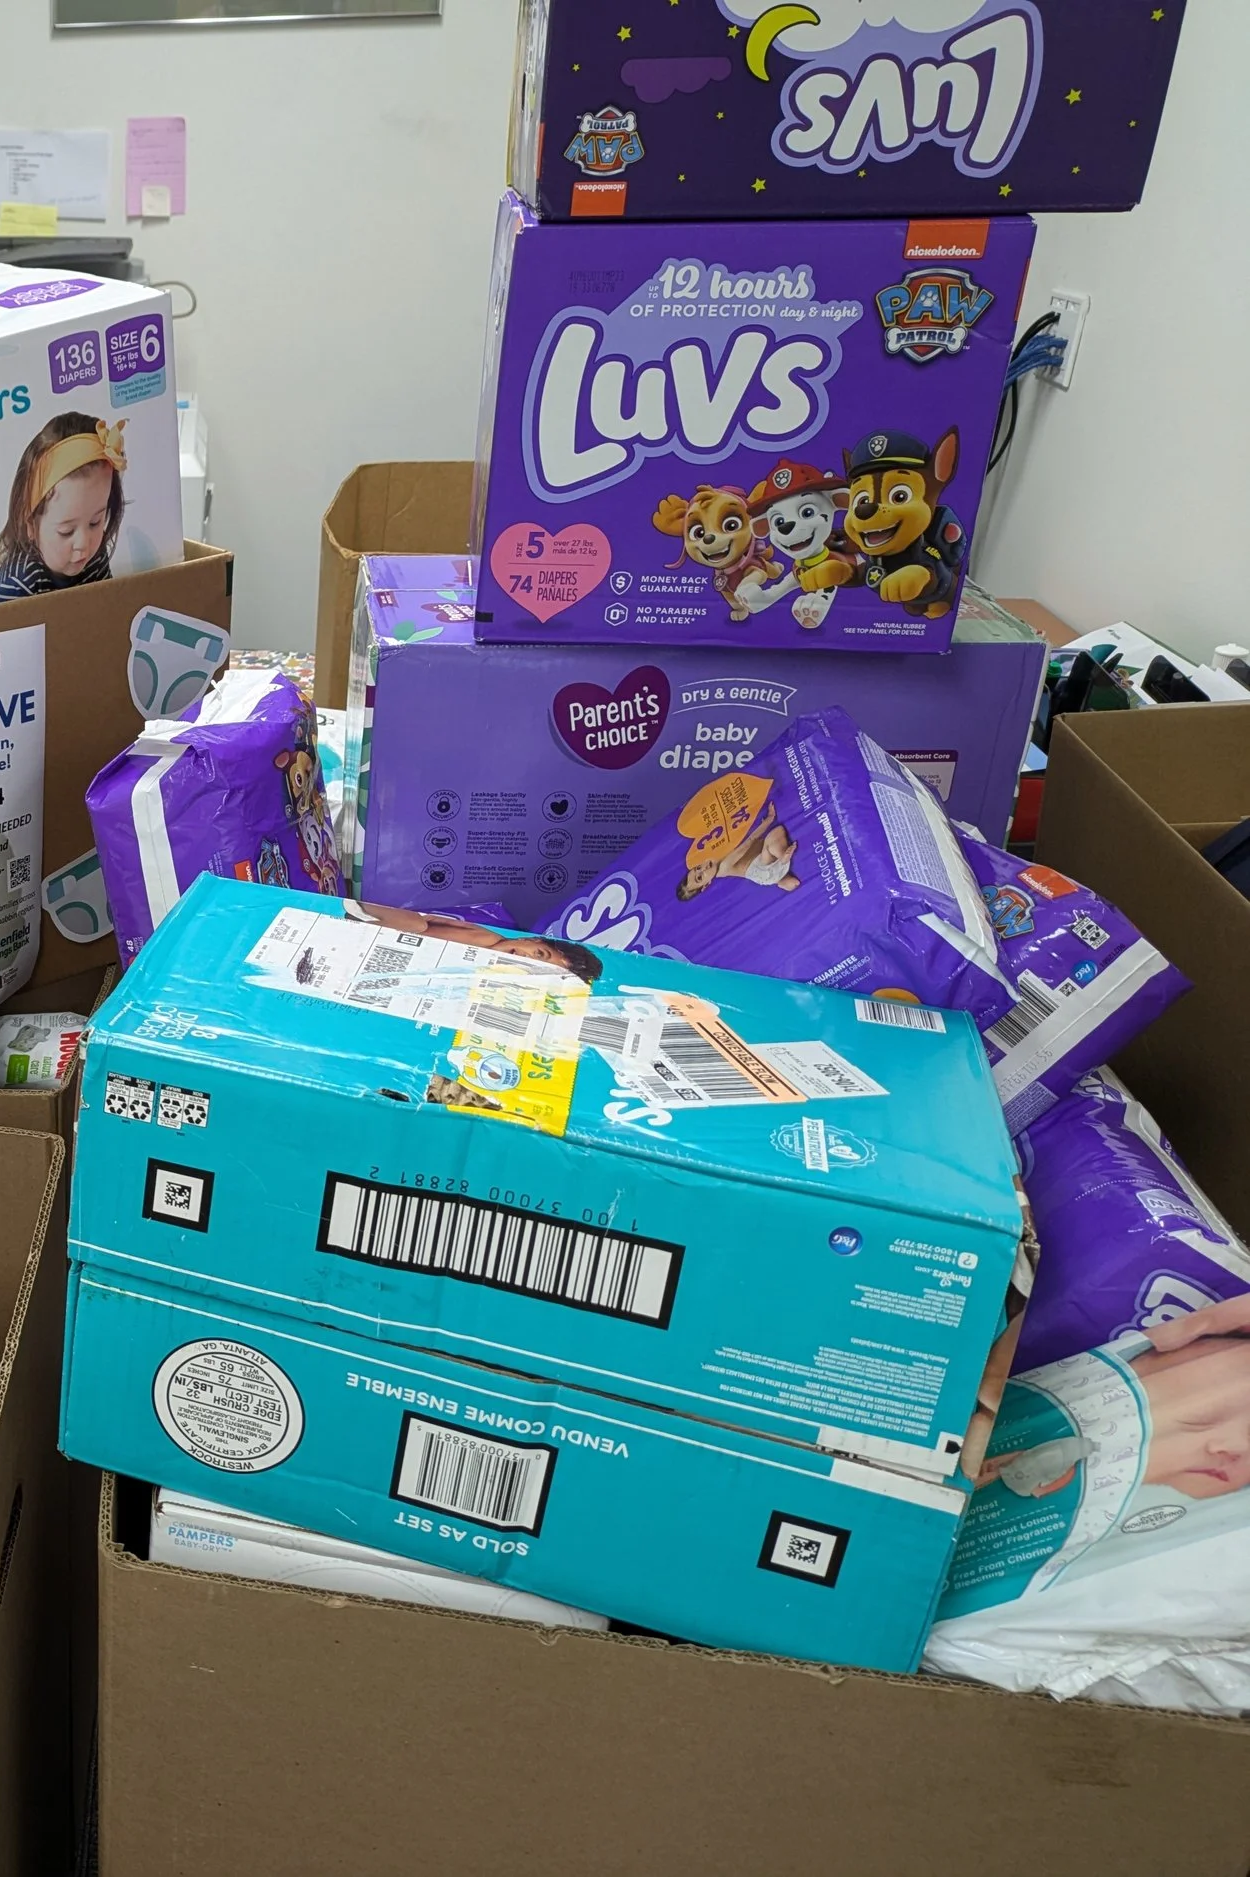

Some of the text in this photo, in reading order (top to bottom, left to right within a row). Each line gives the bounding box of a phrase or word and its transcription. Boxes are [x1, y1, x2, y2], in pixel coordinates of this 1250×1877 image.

[785, 14, 1027, 164] Luvs
[587, 119, 629, 130] PATROL
[564, 131, 645, 165] PAW
[907, 245, 977, 256] nickelodeon
[659, 265, 701, 299] 12
[710, 270, 809, 299] hours
[630, 304, 858, 322] OF PROTECTION day & night
[876, 283, 994, 327] PAW
[110, 324, 160, 362] SIZE 6
[895, 330, 956, 345] PATROL
[55, 340, 96, 372] 136
[58, 366, 97, 385] DIAPERS
[538, 322, 824, 488] Luvs
[525, 531, 545, 559] 5
[582, 539, 593, 547] lbs
[509, 574, 533, 593] 74
[538, 570, 578, 585] DIAPERS
[641, 575, 708, 584] MONEY BACK
[536, 584, 578, 602] PAÑALES
[636, 606, 707, 616] NO PARABENS
[681, 686, 783, 705] Dry & Gentle
[568, 685, 661, 733] Parent's
[585, 722, 650, 751] CHOICE
[695, 723, 758, 745] baby
[471, 791, 527, 799] Leakage Security
[587, 792, 631, 800] Skin-Friendly
[467, 830, 514, 838] Super-Stretchy
[13, 937, 30, 952] Bank
[814, 955, 857, 984] GUARANTEE
[712, 1030, 778, 1086] CONVEYABLE FLOW
[400, 1170, 562, 1216] 37000 82881
[1146, 1196, 1202, 1221] OPEN
[832, 1234, 858, 1248] P&G
[174, 1375, 282, 1413] TEST (ECT) LBS/IN
[186, 1388, 282, 1422] EDGE CRUSH 32
[346, 1371, 630, 1459] VENDU COMME ENSEMBLE
[188, 1445, 255, 1470] WESTROCK
[168, 1526, 234, 1547] PAMPERS
[394, 1511, 529, 1557] SOLD AS SET
[977, 1523, 1018, 1545] Without
[1006, 1520, 1067, 1546] Fragrances
[978, 1545, 1054, 1574] From Chlorine
